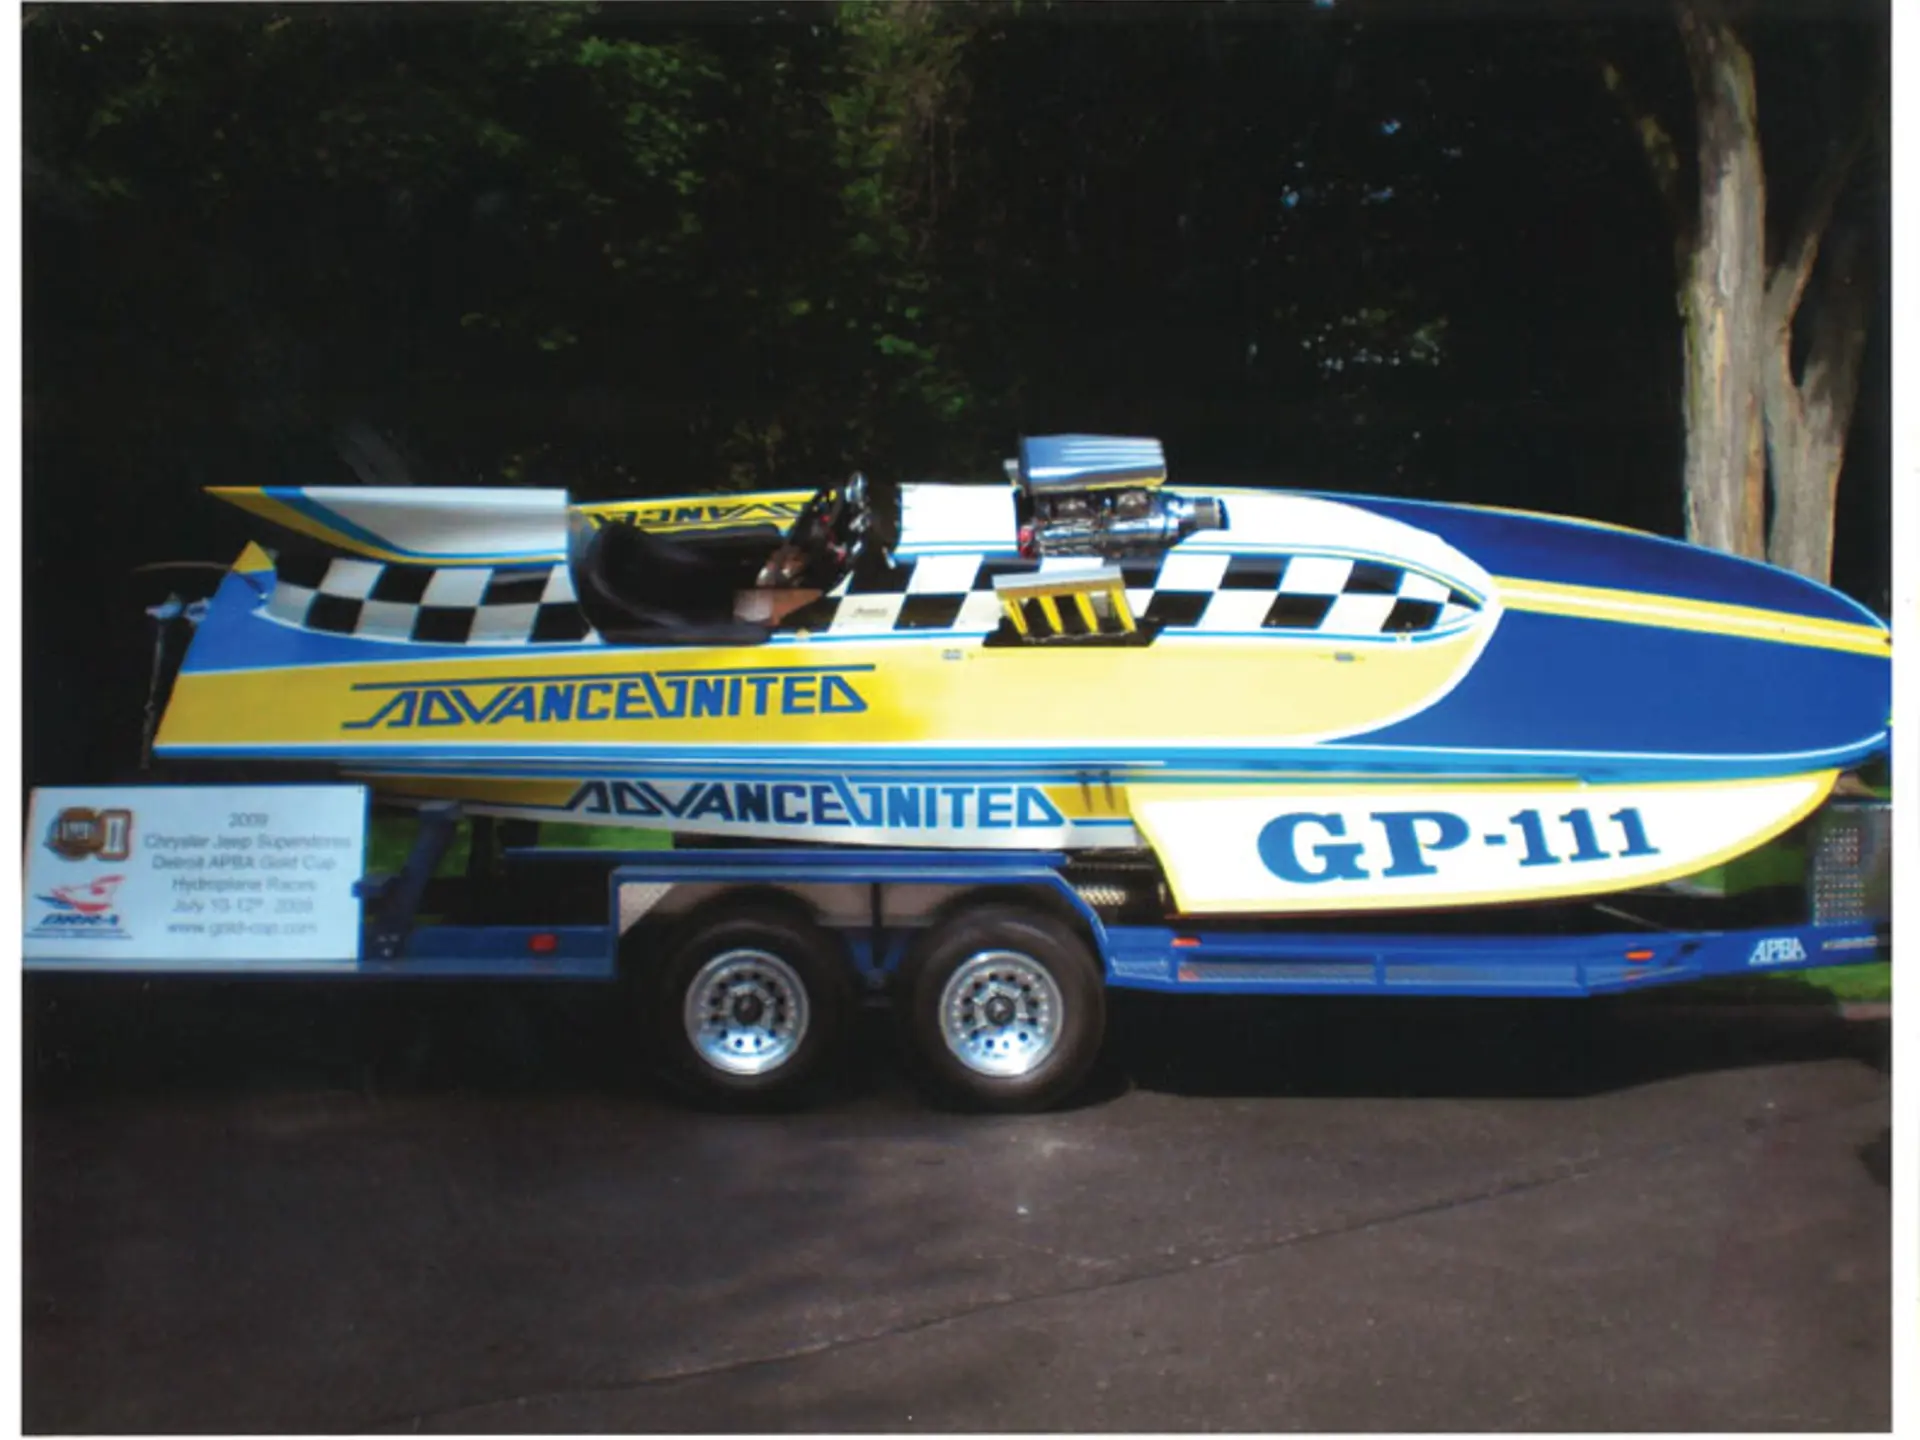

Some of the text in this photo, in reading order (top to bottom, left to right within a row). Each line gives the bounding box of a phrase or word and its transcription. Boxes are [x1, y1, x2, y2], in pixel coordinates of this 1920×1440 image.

[143, 833, 352, 851] Chrysler Jeep Superstores
[1256, 807, 1661, 884] GP-111
[152, 854, 337, 871] Detroit APBA Gold Cup
[172, 876, 317, 893] Hydroplane Races
[172, 898, 205, 914] July
